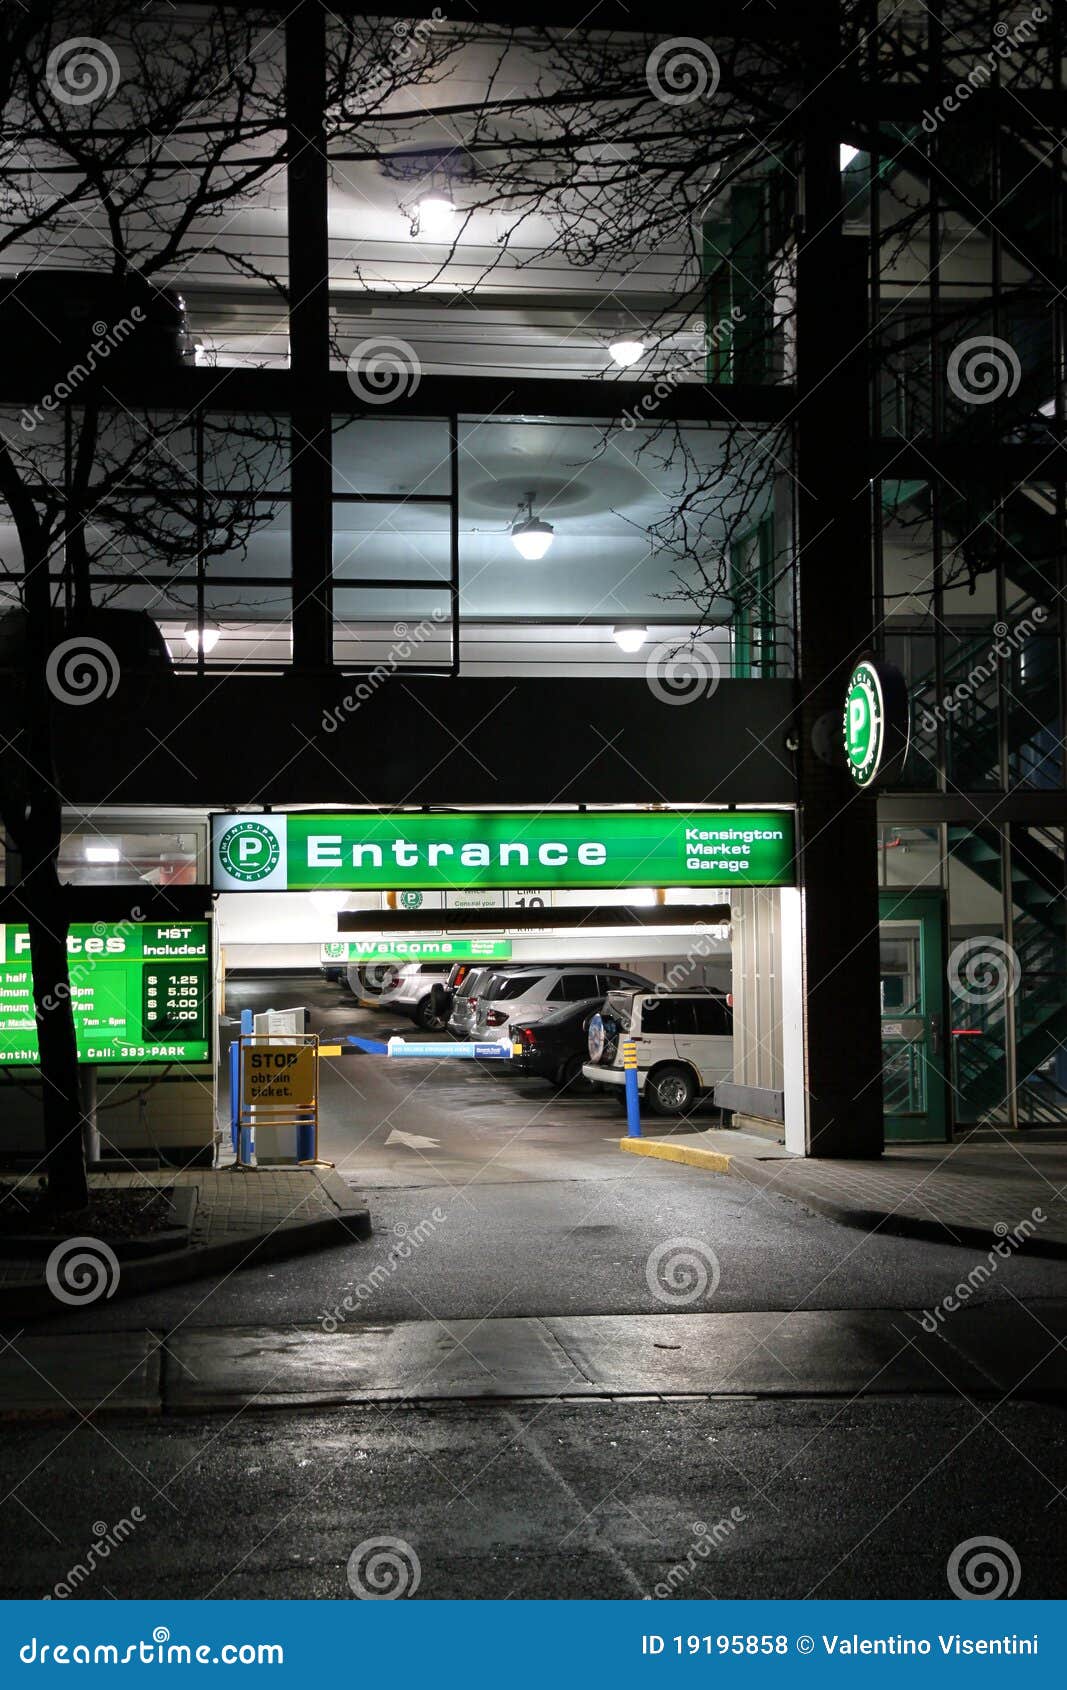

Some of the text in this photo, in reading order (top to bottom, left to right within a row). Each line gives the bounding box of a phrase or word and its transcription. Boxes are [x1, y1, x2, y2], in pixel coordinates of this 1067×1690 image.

[849, 698, 866, 745] P
[221, 823, 277, 850] MUNICIPAL
[685, 828, 783, 843] Kensington
[239, 837, 263, 861] P
[307, 835, 608, 868] Entrance
[686, 843, 751, 855] Market
[222, 857, 277, 880] PARKING
[686, 857, 749, 872] Garage
[157, 928, 192, 939] HST
[14, 933, 126, 954] Rtes
[143, 944, 206, 955] Included
[355, 942, 453, 953] Welcome
[6, 973, 27, 983] half
[147, 975, 198, 985] $ 1.25
[147, 987, 198, 997] $ 5.50
[147, 999, 198, 1009] $ 4.00
[147, 1011, 158, 1021] $
[0, 1050, 39, 1061] onthly
[87, 1047, 116, 1058] Call:
[121, 1046, 185, 1057] 393-PARK
[251, 1053, 298, 1068] STOP
[251, 1071, 291, 1084] obtain
